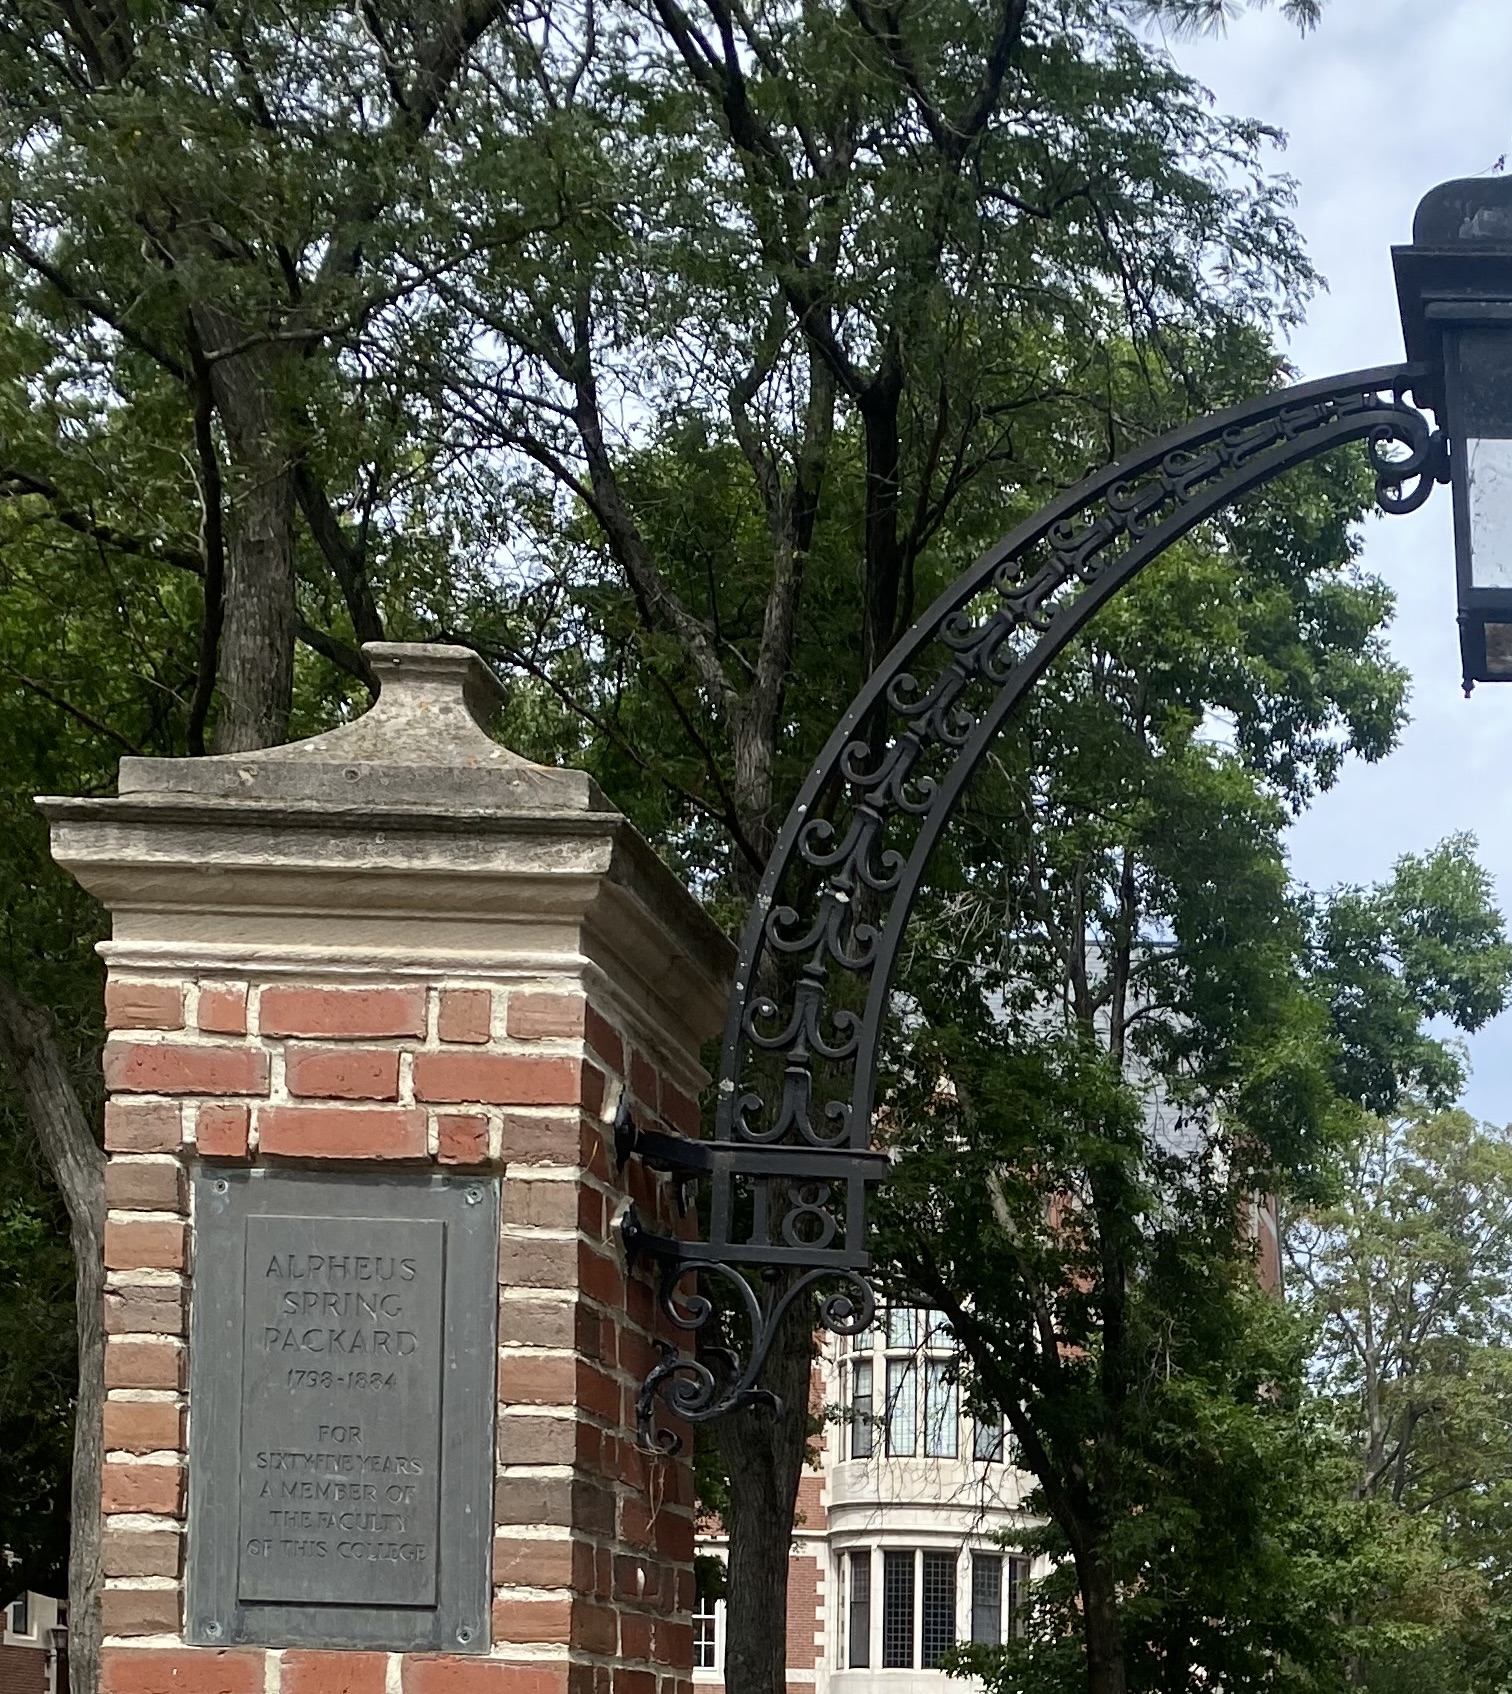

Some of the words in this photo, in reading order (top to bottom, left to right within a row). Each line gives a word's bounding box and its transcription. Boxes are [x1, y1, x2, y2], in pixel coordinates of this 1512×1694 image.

[266, 1254, 417, 1282] ALPHEUS
[283, 1290, 403, 1318] SPRING
[265, 1327, 418, 1355] PACKARD
[318, 1424, 363, 1444] FOR
[356, 1454, 424, 1476] YEARS
[259, 1480, 273, 1498] A
[282, 1480, 377, 1502] MEMBER
[385, 1484, 416, 1505] OF
[269, 1509, 313, 1529] THE
[317, 1511, 409, 1533] FACULTY
[246, 1538, 273, 1557] OF
[280, 1539, 328, 1558] THIS
[336, 1541, 428, 1562] COLLEGE
